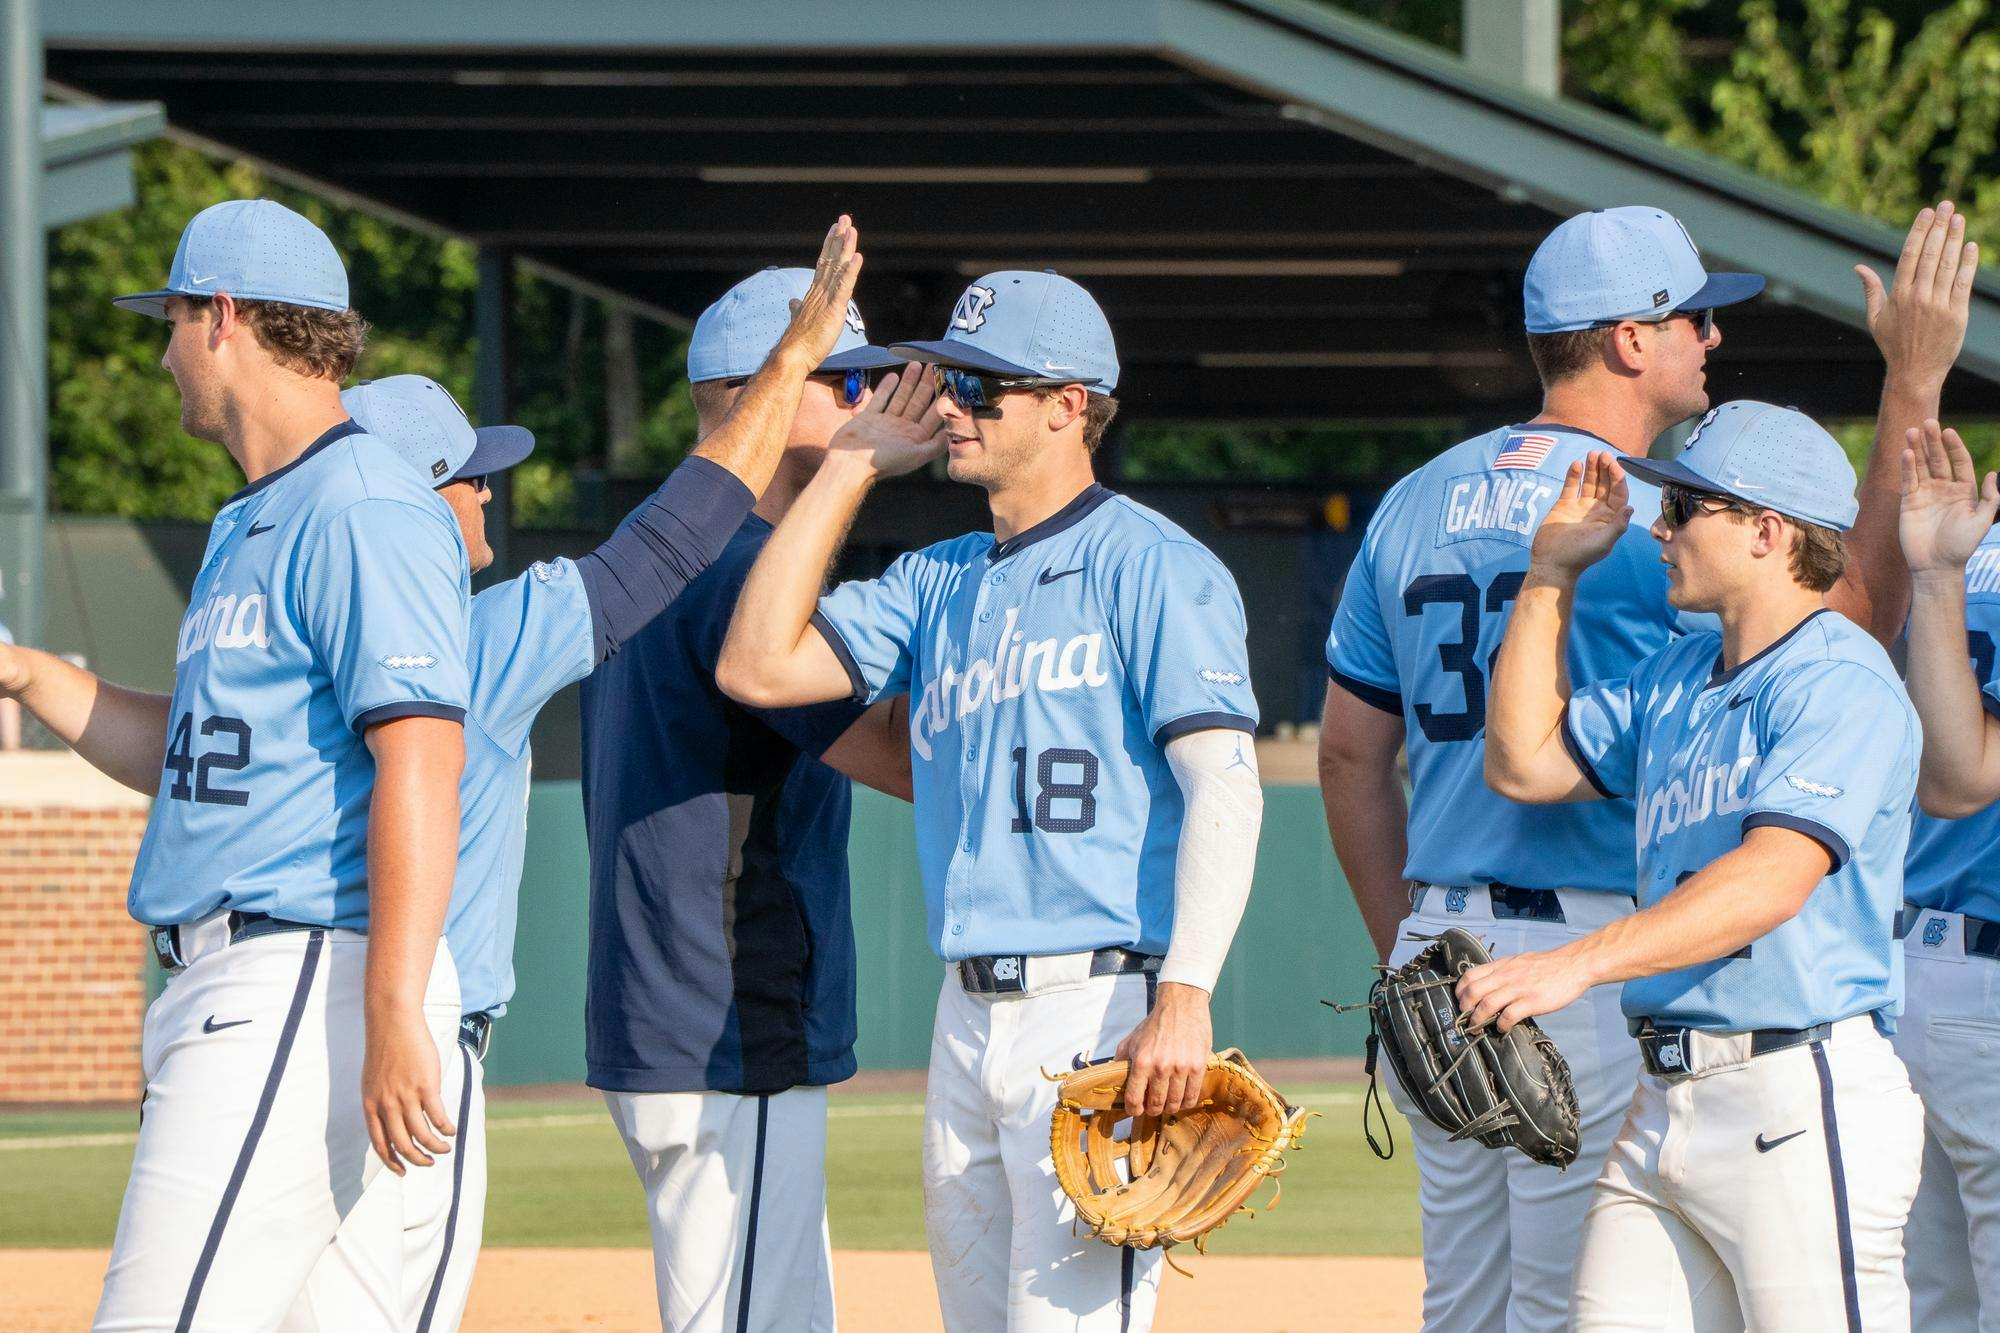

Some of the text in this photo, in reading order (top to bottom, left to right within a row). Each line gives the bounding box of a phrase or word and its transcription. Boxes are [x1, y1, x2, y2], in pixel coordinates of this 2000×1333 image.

[1446, 478, 1552, 536] GAINES
[165, 712, 252, 806] 42
[1011, 747, 1098, 833] 18
